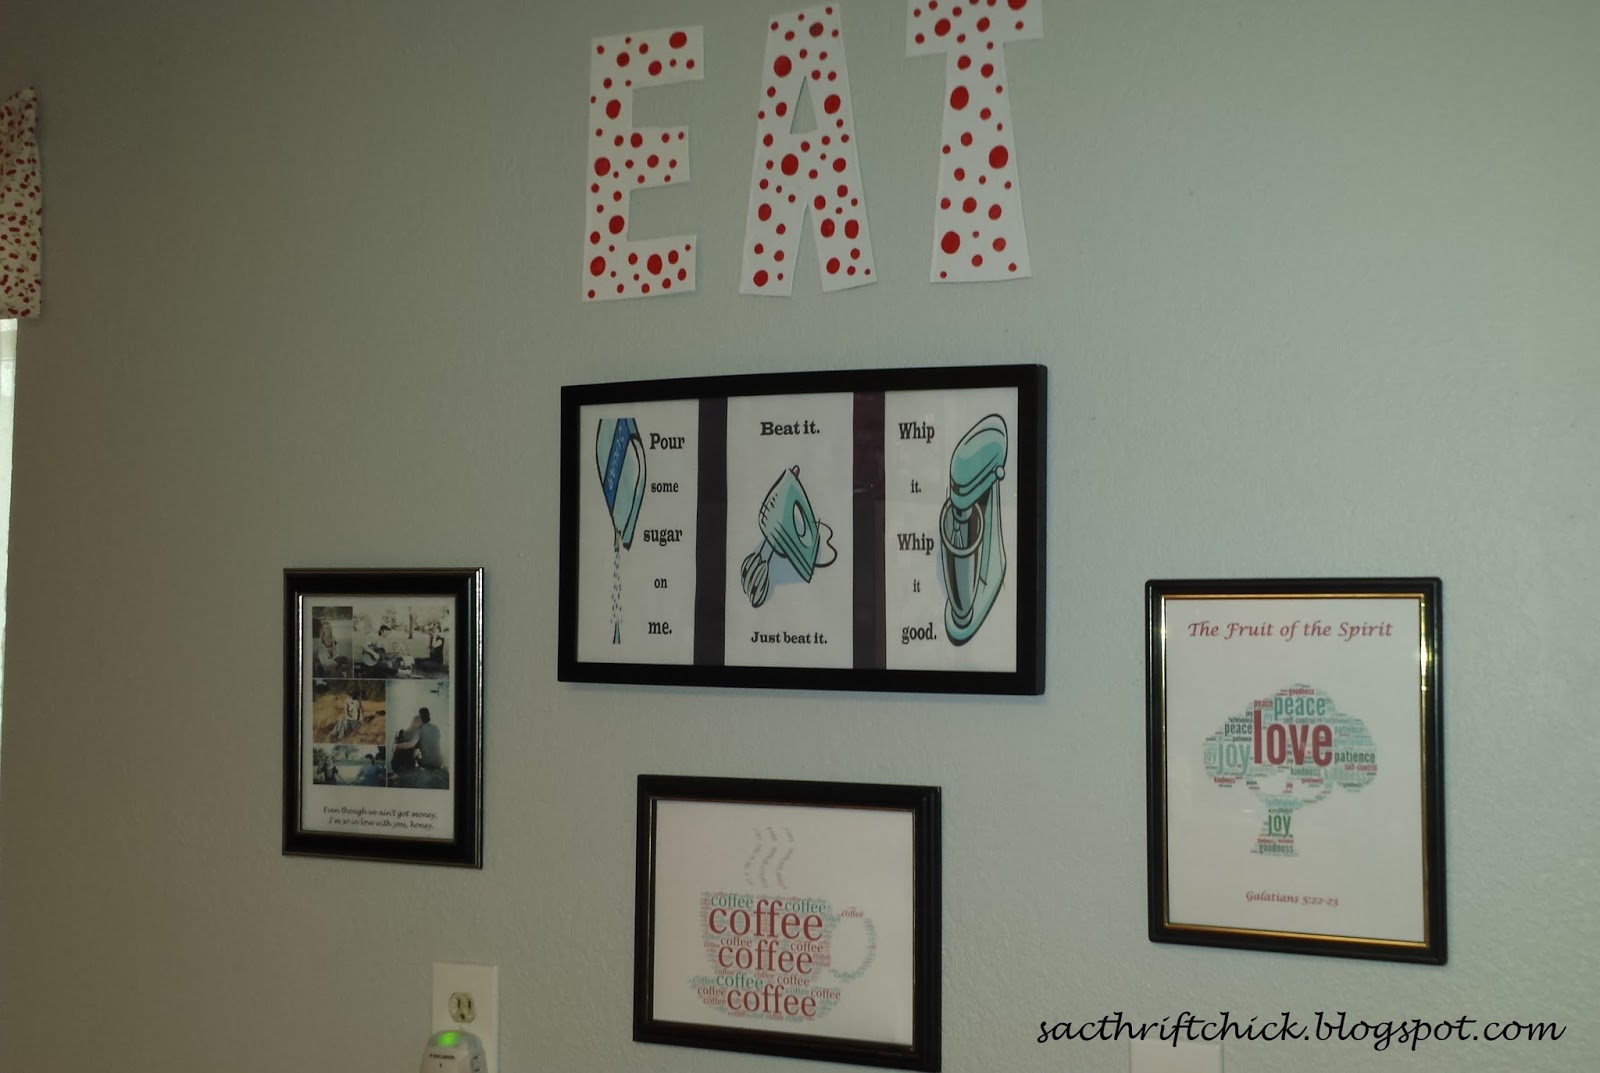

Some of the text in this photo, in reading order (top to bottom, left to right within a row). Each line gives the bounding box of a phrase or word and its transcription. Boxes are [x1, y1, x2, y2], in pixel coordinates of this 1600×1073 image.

[583, 0, 1043, 302] EAT
[760, 420, 820, 436] Beat it.
[899, 422, 935, 443] Whip
[650, 433, 685, 449] Pour
[651, 481, 679, 493] some
[911, 480, 922, 493] it.
[643, 527, 683, 546] sugar
[897, 533, 934, 555] Whip
[654, 578, 668, 589] on
[913, 580, 921, 593] it
[648, 621, 672, 635] me.
[901, 622, 937, 644] good.
[1188, 620, 1393, 642] The Fruit of the Spirit
[751, 631, 828, 644] Just beat it.
[1253, 699, 1274, 708] peace
[1274, 697, 1326, 721] peace
[1225, 723, 1253, 737] peace
[1253, 709, 1333, 767] love
[1216, 735, 1251, 777] joy
[1334, 750, 1376, 765] patience
[323, 806, 340, 814] Even
[341, 807, 366, 817] though
[379, 809, 396, 817] ain't
[397, 811, 411, 819] got
[360, 818, 375, 827] love
[376, 819, 392, 828] with
[393, 822, 408, 830] you,
[1267, 814, 1292, 838] joy
[1258, 843, 1294, 854] goodness
[710, 893, 754, 909] coffee
[1246, 890, 1299, 904] Galatians
[784, 900, 826, 914] coffee
[841, 909, 864, 919] coffee
[708, 898, 823, 942] coffee
[720, 936, 753, 948] coffee
[790, 941, 824, 953] coffee
[718, 939, 813, 975] coffee
[716, 972, 764, 990] coffee
[753, 970, 776, 980] coffee
[776, 974, 810, 987] coffee
[697, 985, 727, 997] coffee
[810, 988, 842, 1000] coffee
[702, 996, 727, 1006] coffee
[726, 983, 817, 1018] coffee
